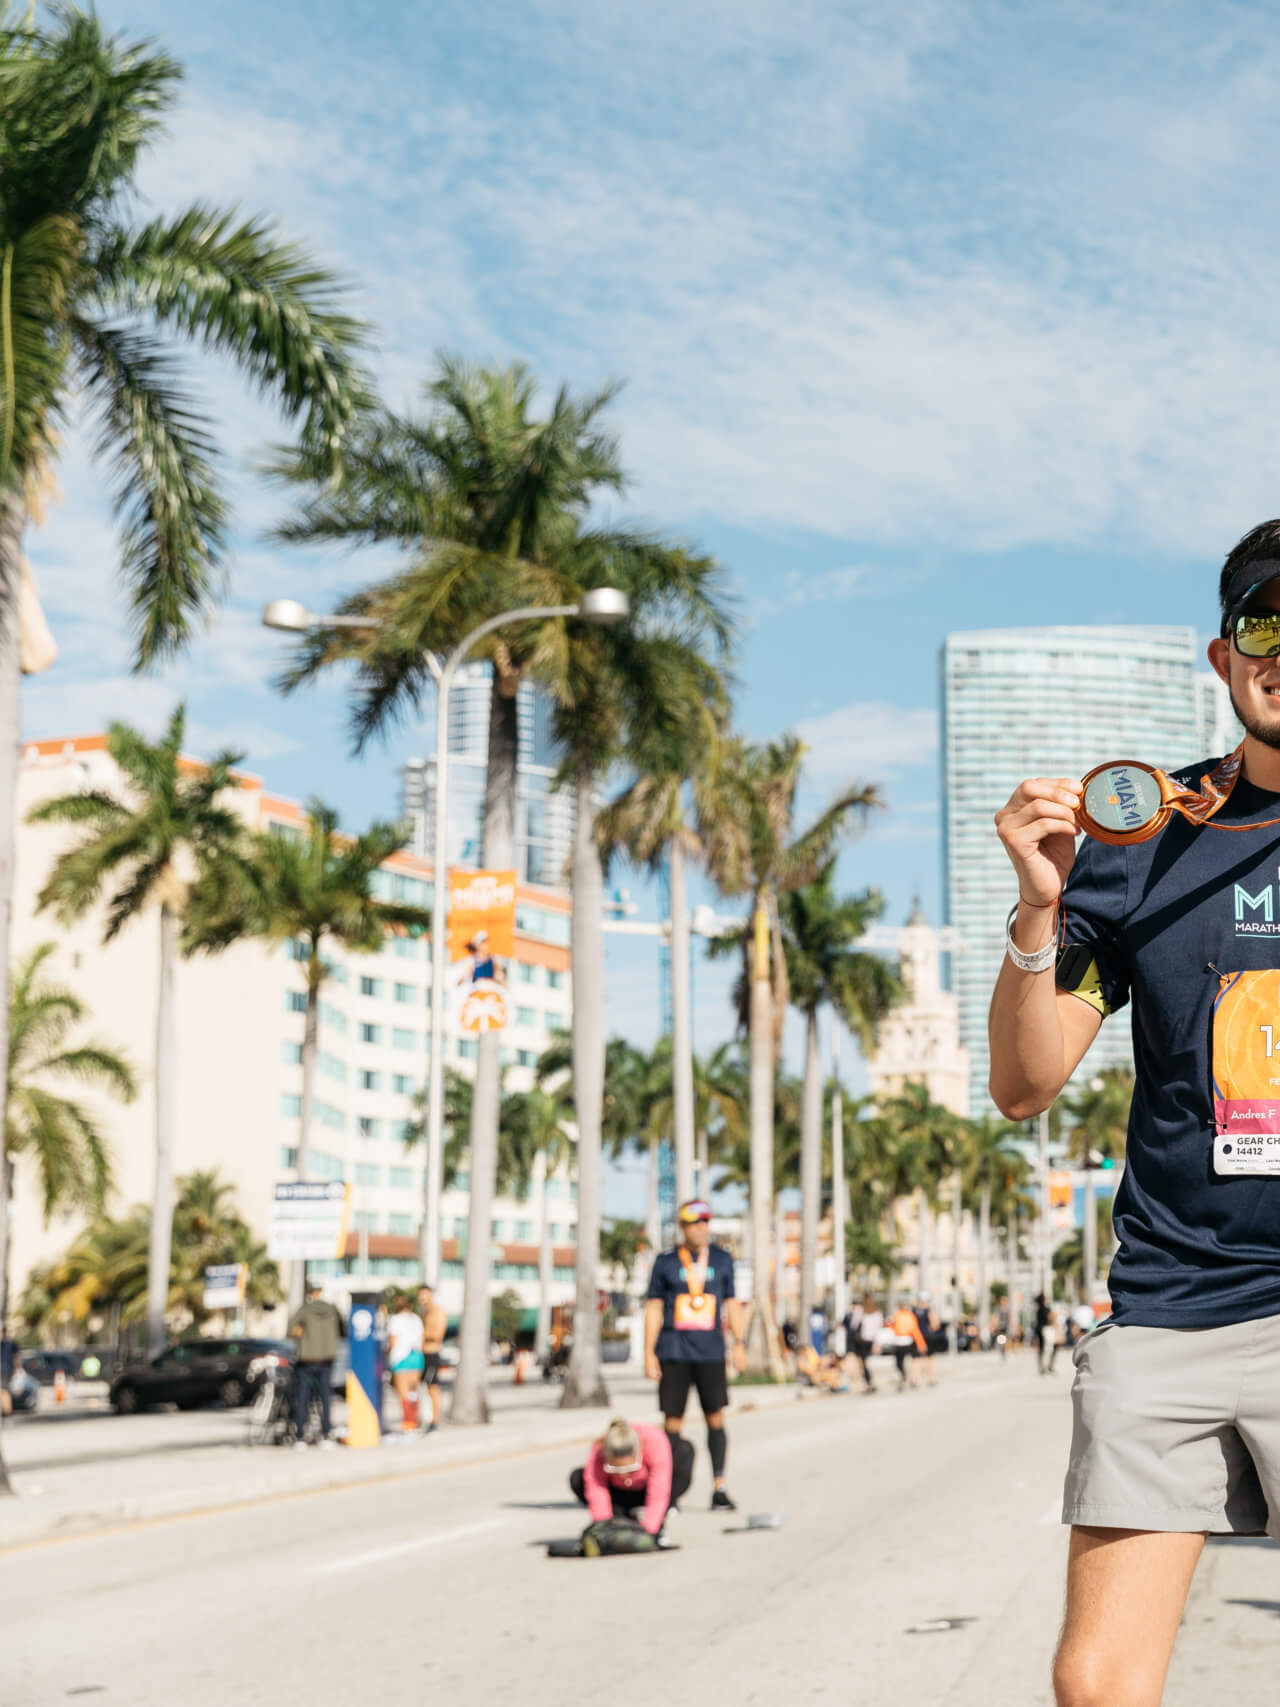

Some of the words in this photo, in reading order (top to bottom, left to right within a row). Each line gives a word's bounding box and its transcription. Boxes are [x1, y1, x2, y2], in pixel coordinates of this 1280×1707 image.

[1112, 768, 1142, 826] MIAMI
[1231, 1110, 1266, 1120] Andres
[1268, 1108, 1277, 1119] F
[1236, 1137, 1264, 1145] GEAR
[1237, 1147, 1263, 1156] 14412
